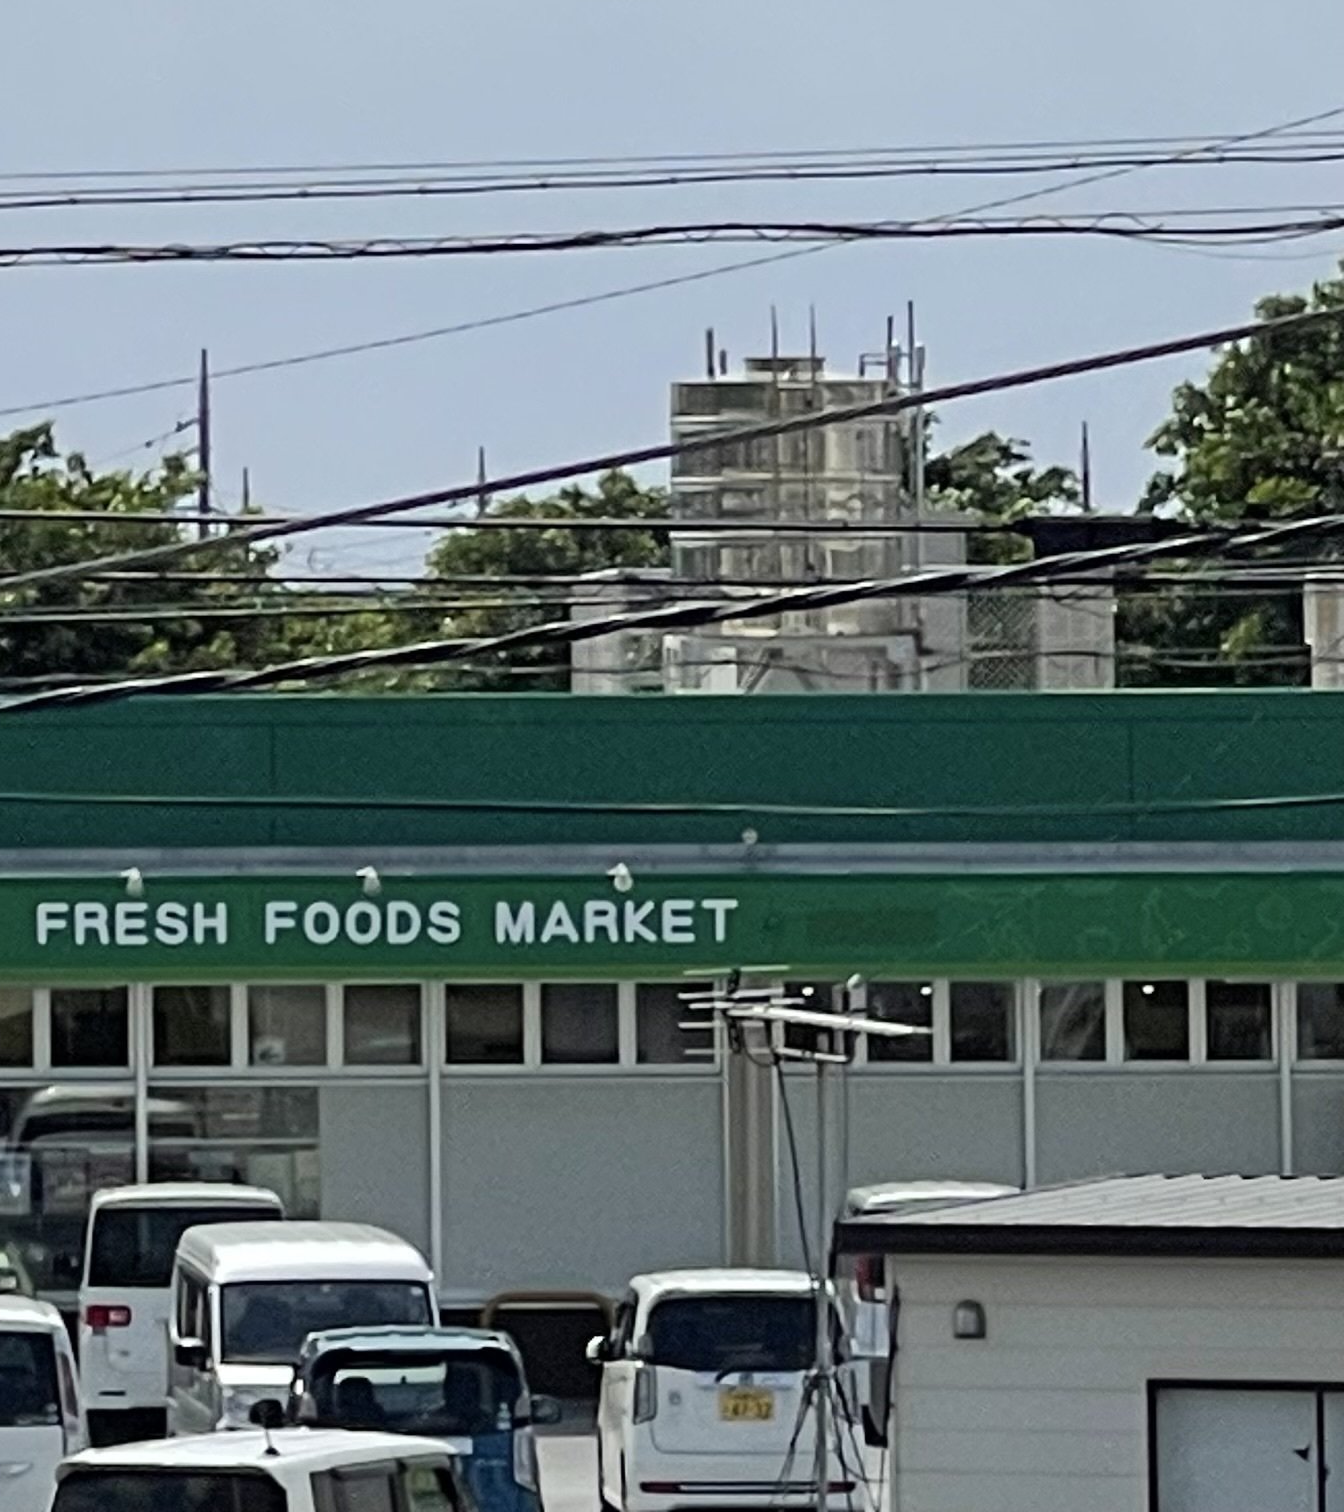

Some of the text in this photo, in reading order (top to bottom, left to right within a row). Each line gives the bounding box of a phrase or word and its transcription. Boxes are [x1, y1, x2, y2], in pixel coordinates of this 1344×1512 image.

[35, 898, 739, 945] FRESH FOODS MARKET
